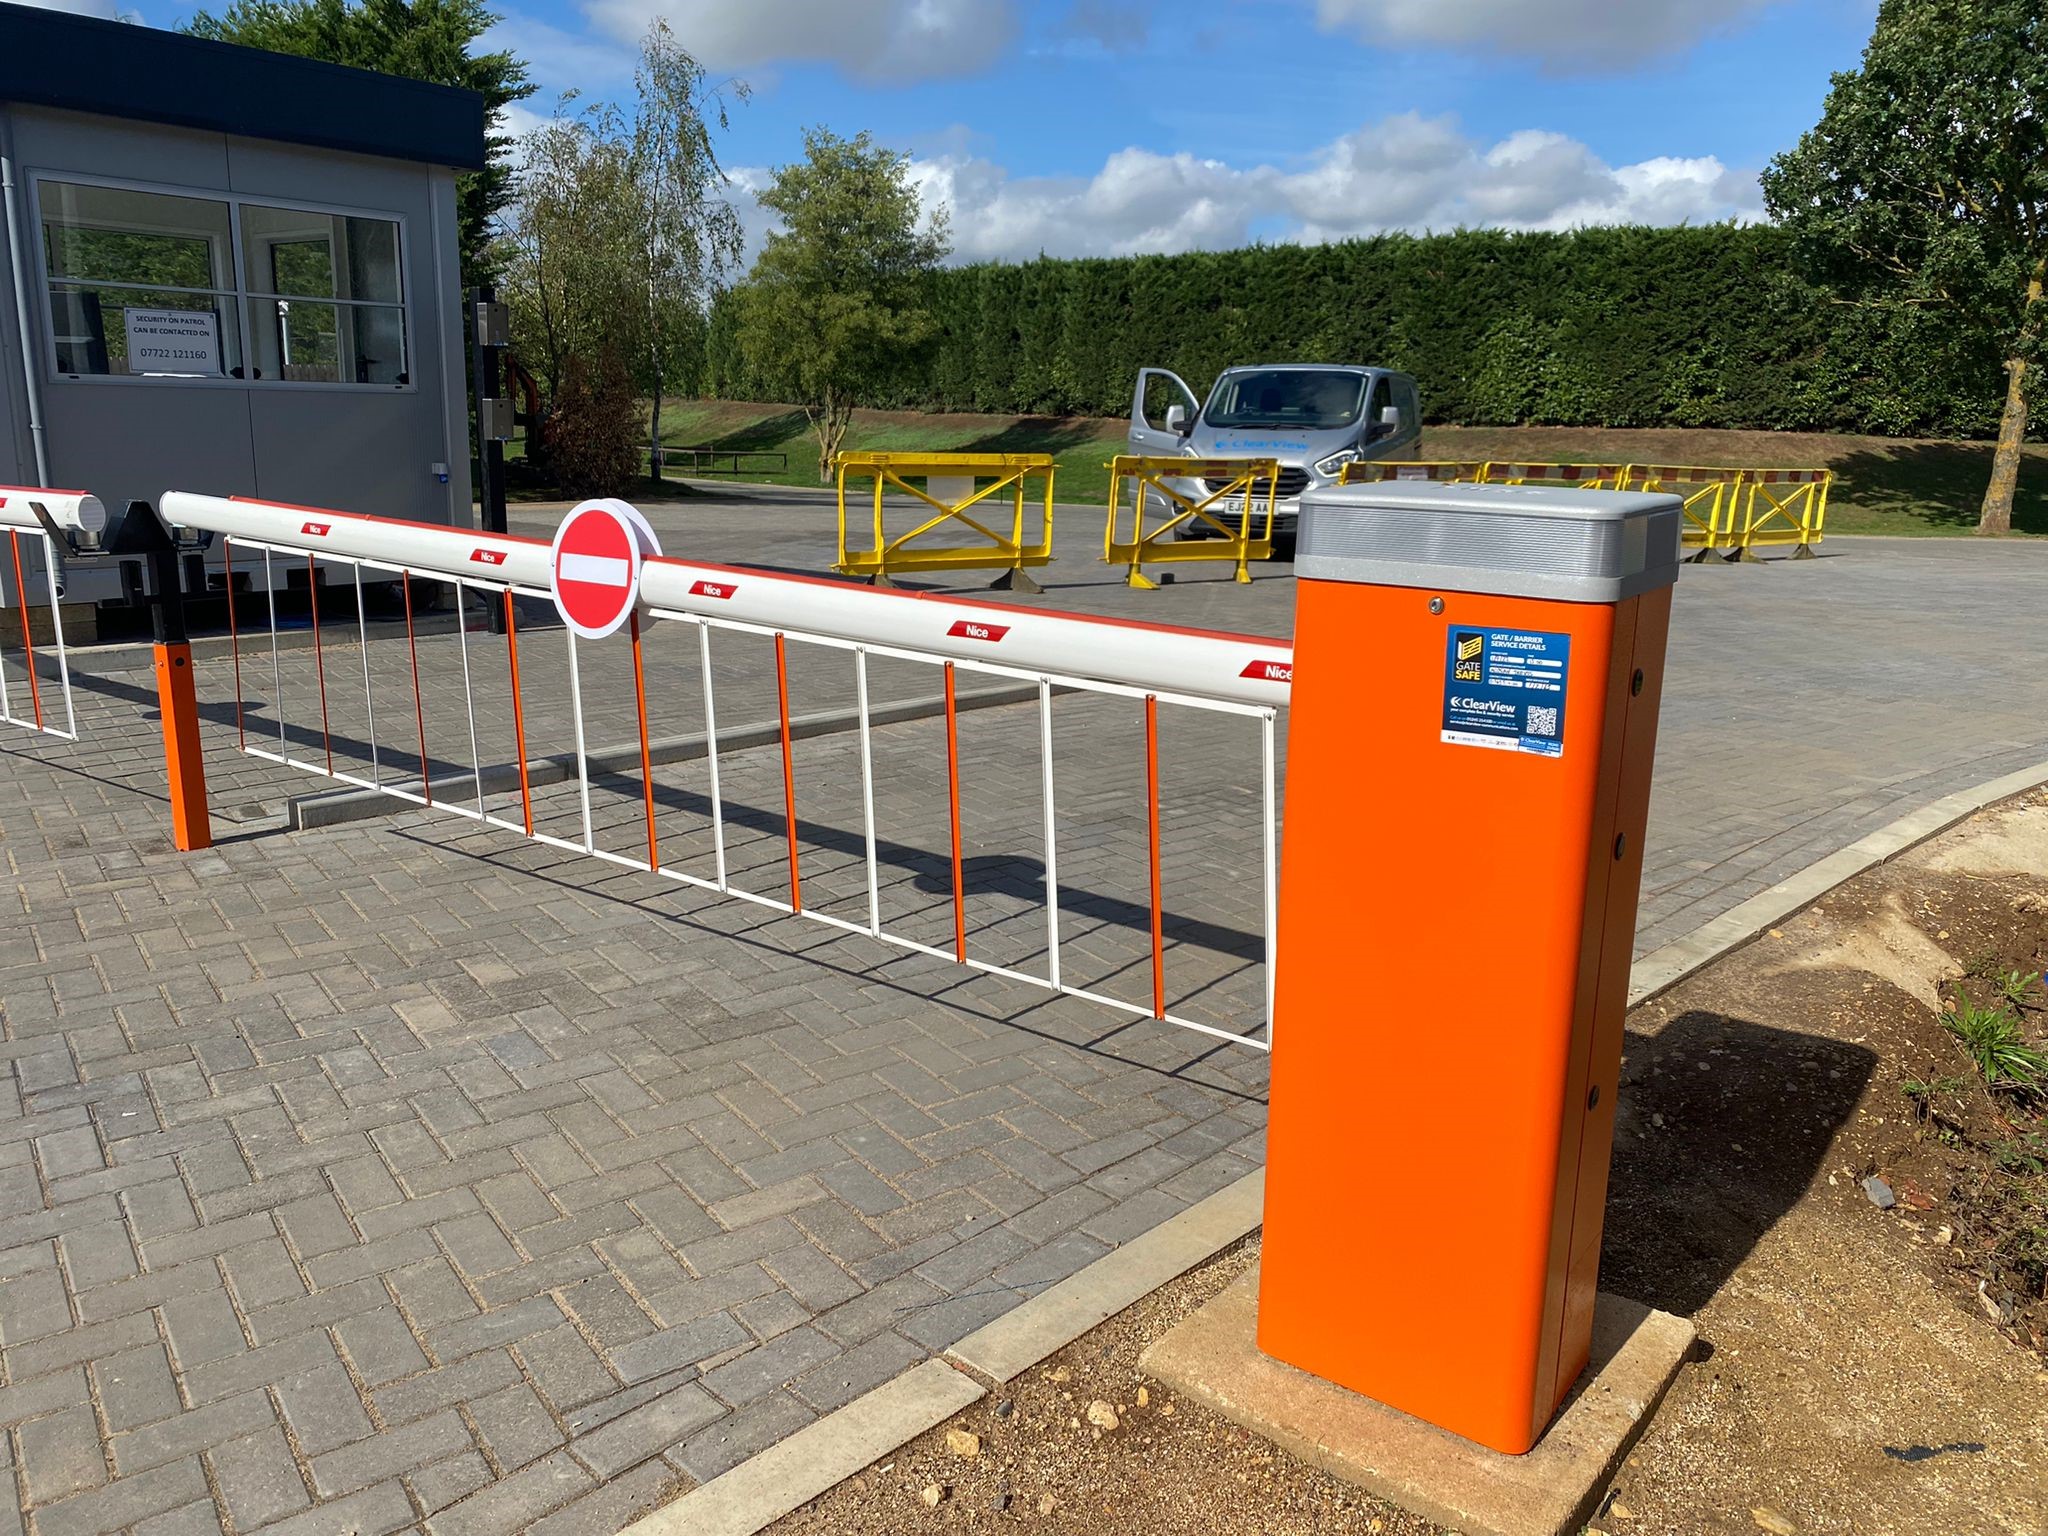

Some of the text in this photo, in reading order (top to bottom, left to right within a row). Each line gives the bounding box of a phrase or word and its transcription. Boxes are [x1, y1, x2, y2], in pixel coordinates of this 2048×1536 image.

[136, 315, 167, 323] SECURITY
[180, 318, 206, 326] PATROL
[159, 328, 198, 336] CONTACTED
[140, 348, 207, 360] 07722 121160
[1232, 439, 1308, 450] ClearView
[1256, 503, 1273, 513] AA
[310, 525, 321, 534] Nice
[481, 552, 496, 562] Nice
[704, 584, 721, 596] Nice
[966, 624, 988, 638] Nice
[1491, 633, 1510, 641] GATE
[1514, 635, 1544, 644] BARRIER
[1490, 640, 1547, 651] SERVICE DETAILS
[1456, 660, 1481, 671] GATE
[1265, 664, 1292, 680] Nice
[1455, 669, 1481, 681] SAFE
[1461, 697, 1516, 713] ClearView
